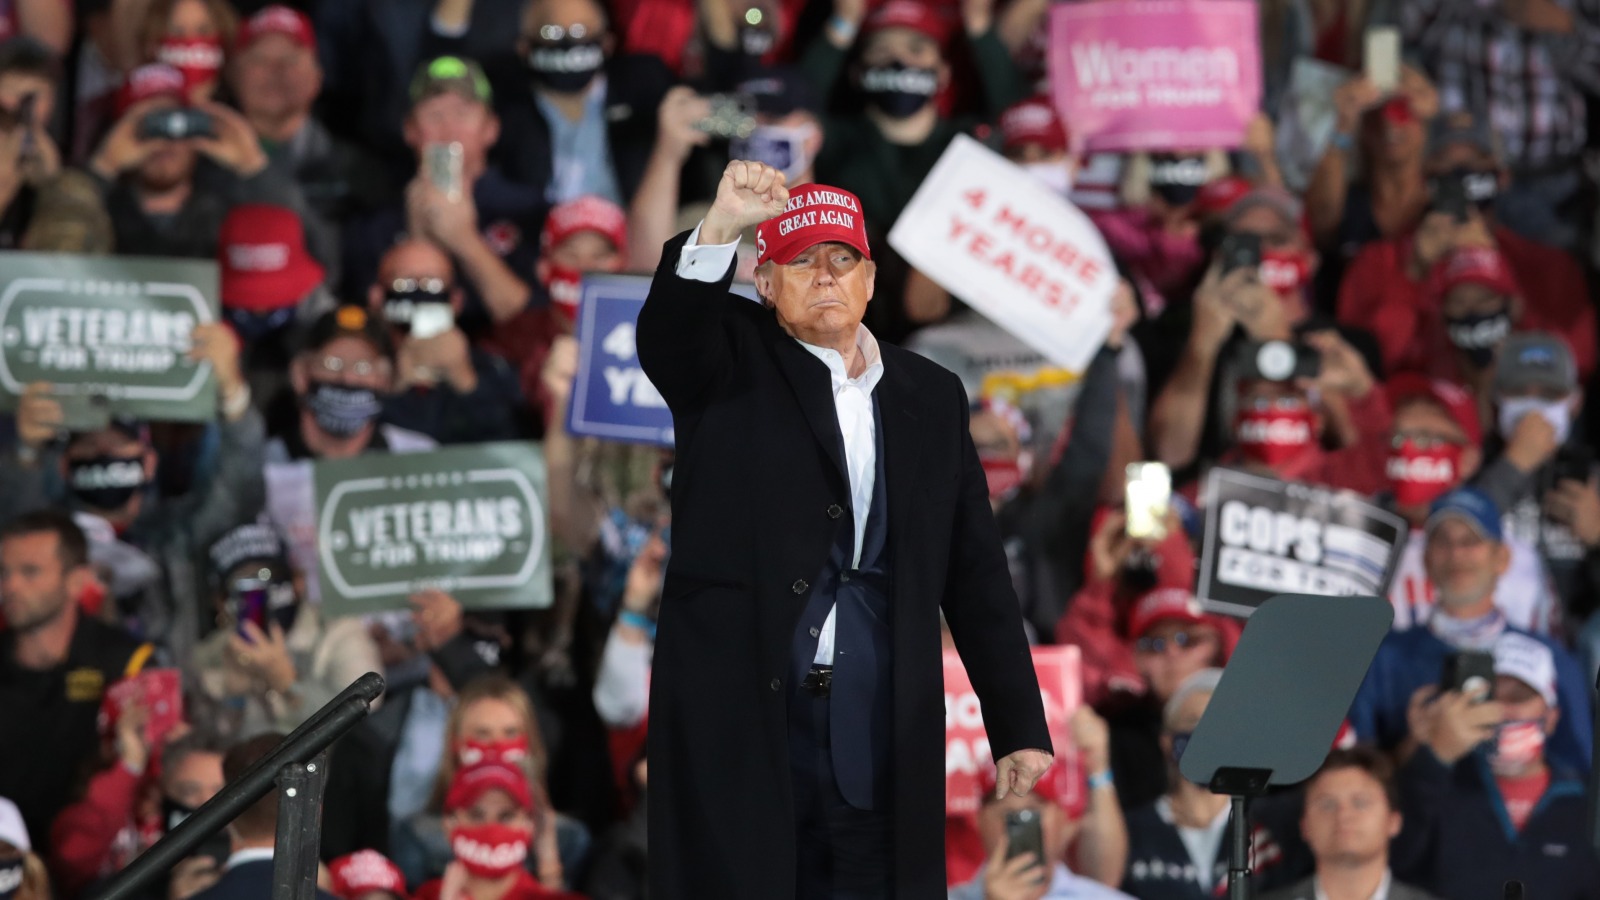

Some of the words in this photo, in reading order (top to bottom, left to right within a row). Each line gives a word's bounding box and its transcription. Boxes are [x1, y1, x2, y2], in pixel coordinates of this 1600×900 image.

[1070, 42, 1238, 87] Women
[805, 190, 858, 213] AMERICA
[962, 187, 989, 211] 4
[778, 210, 817, 237] GREAT
[819, 209, 854, 231] AGAIN
[22, 306, 193, 353] VETERANS
[603, 321, 635, 362] 4
[39, 348, 88, 371] FOR
[93, 351, 176, 374] TRUMP
[348, 496, 521, 548] VETERANS
[1220, 500, 1322, 564] COPS
[369, 544, 416, 569] FOR
[423, 536, 505, 565] TRUMP
[1228, 553, 1286, 582] FOR
[454, 834, 527, 869] MAGA
